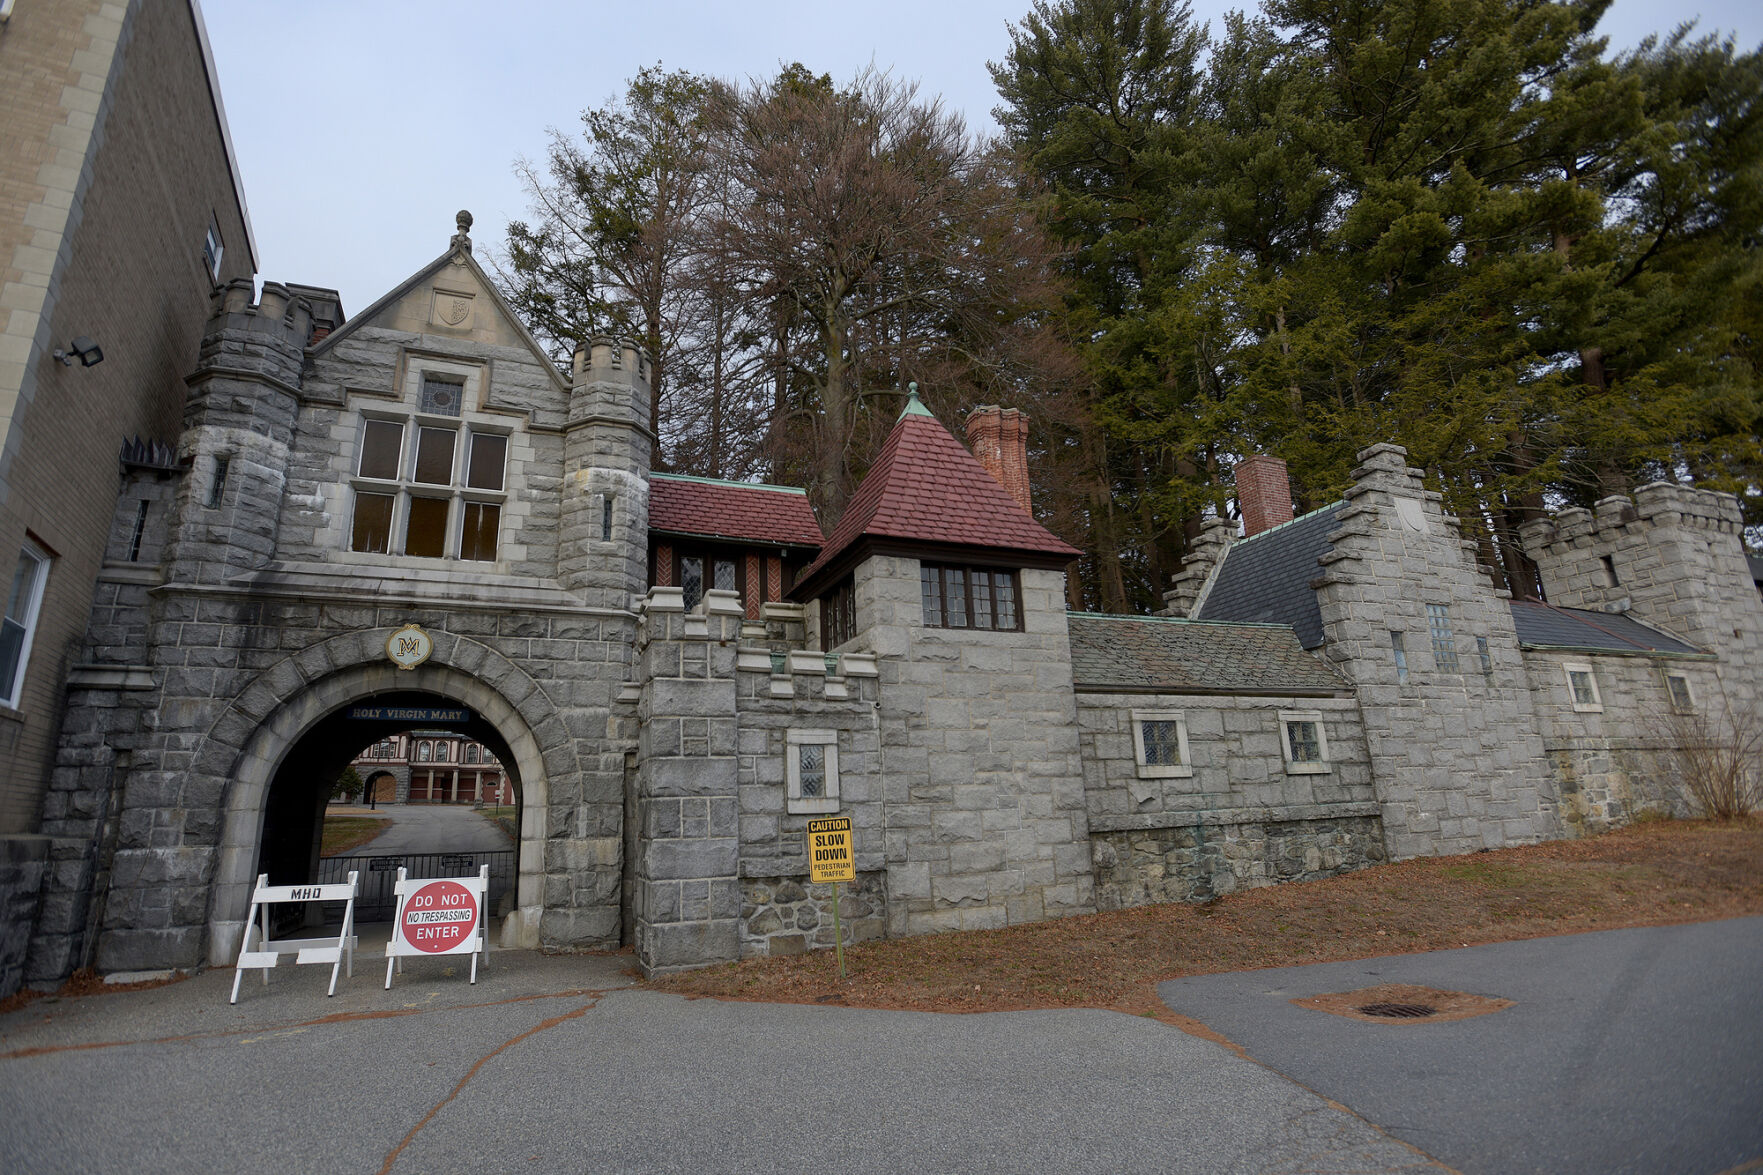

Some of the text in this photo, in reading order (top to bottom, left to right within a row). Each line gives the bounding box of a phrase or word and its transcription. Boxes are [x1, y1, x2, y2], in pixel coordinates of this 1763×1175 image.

[353, 708, 462, 720] HOLY VIRGIN MARY
[811, 820, 847, 831] CAUTION
[816, 834, 844, 846] SLOW
[816, 848, 847, 860] DOWN
[814, 862, 850, 870] PEDESTRIAN
[821, 870, 845, 878] TRAFFIC
[415, 894, 467, 907] DO NOT
[407, 909, 471, 923] NO TRESPASSING
[416, 926, 459, 940] ENTER
